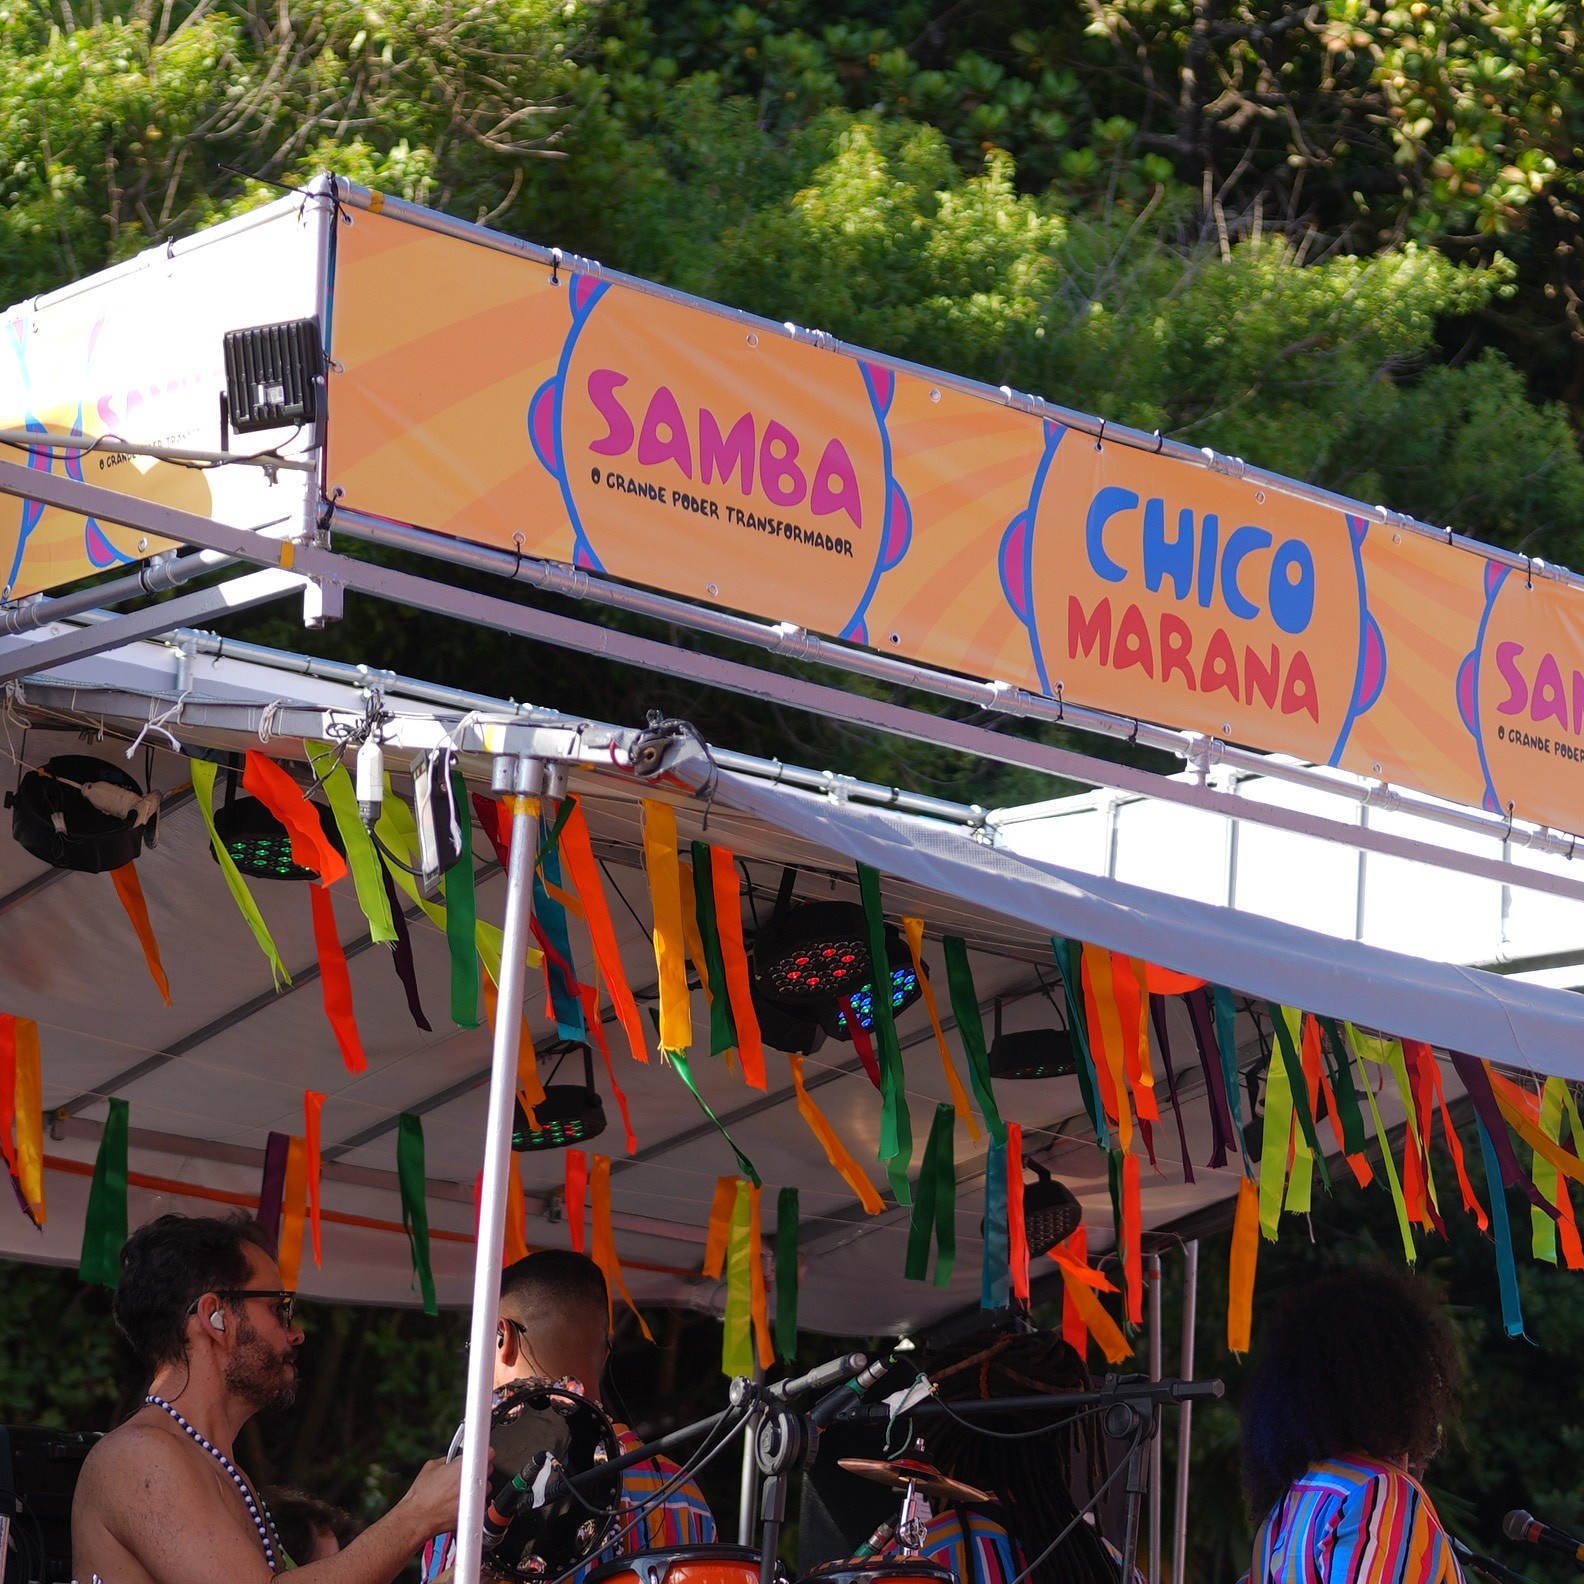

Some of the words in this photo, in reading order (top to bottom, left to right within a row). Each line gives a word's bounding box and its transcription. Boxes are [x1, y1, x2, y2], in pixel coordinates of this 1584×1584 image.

[586, 369, 863, 530] SAMBA
[590, 466, 601, 485] O
[606, 471, 668, 504] GRANDE
[672, 489, 721, 521] PODER
[725, 504, 854, 559] TRANSFORMADOR
[1084, 486, 1315, 635] CHICO
[1067, 595, 1320, 724] MARANA
[1497, 726, 1506, 739] O
[1508, 729, 1550, 758] GRANDE
